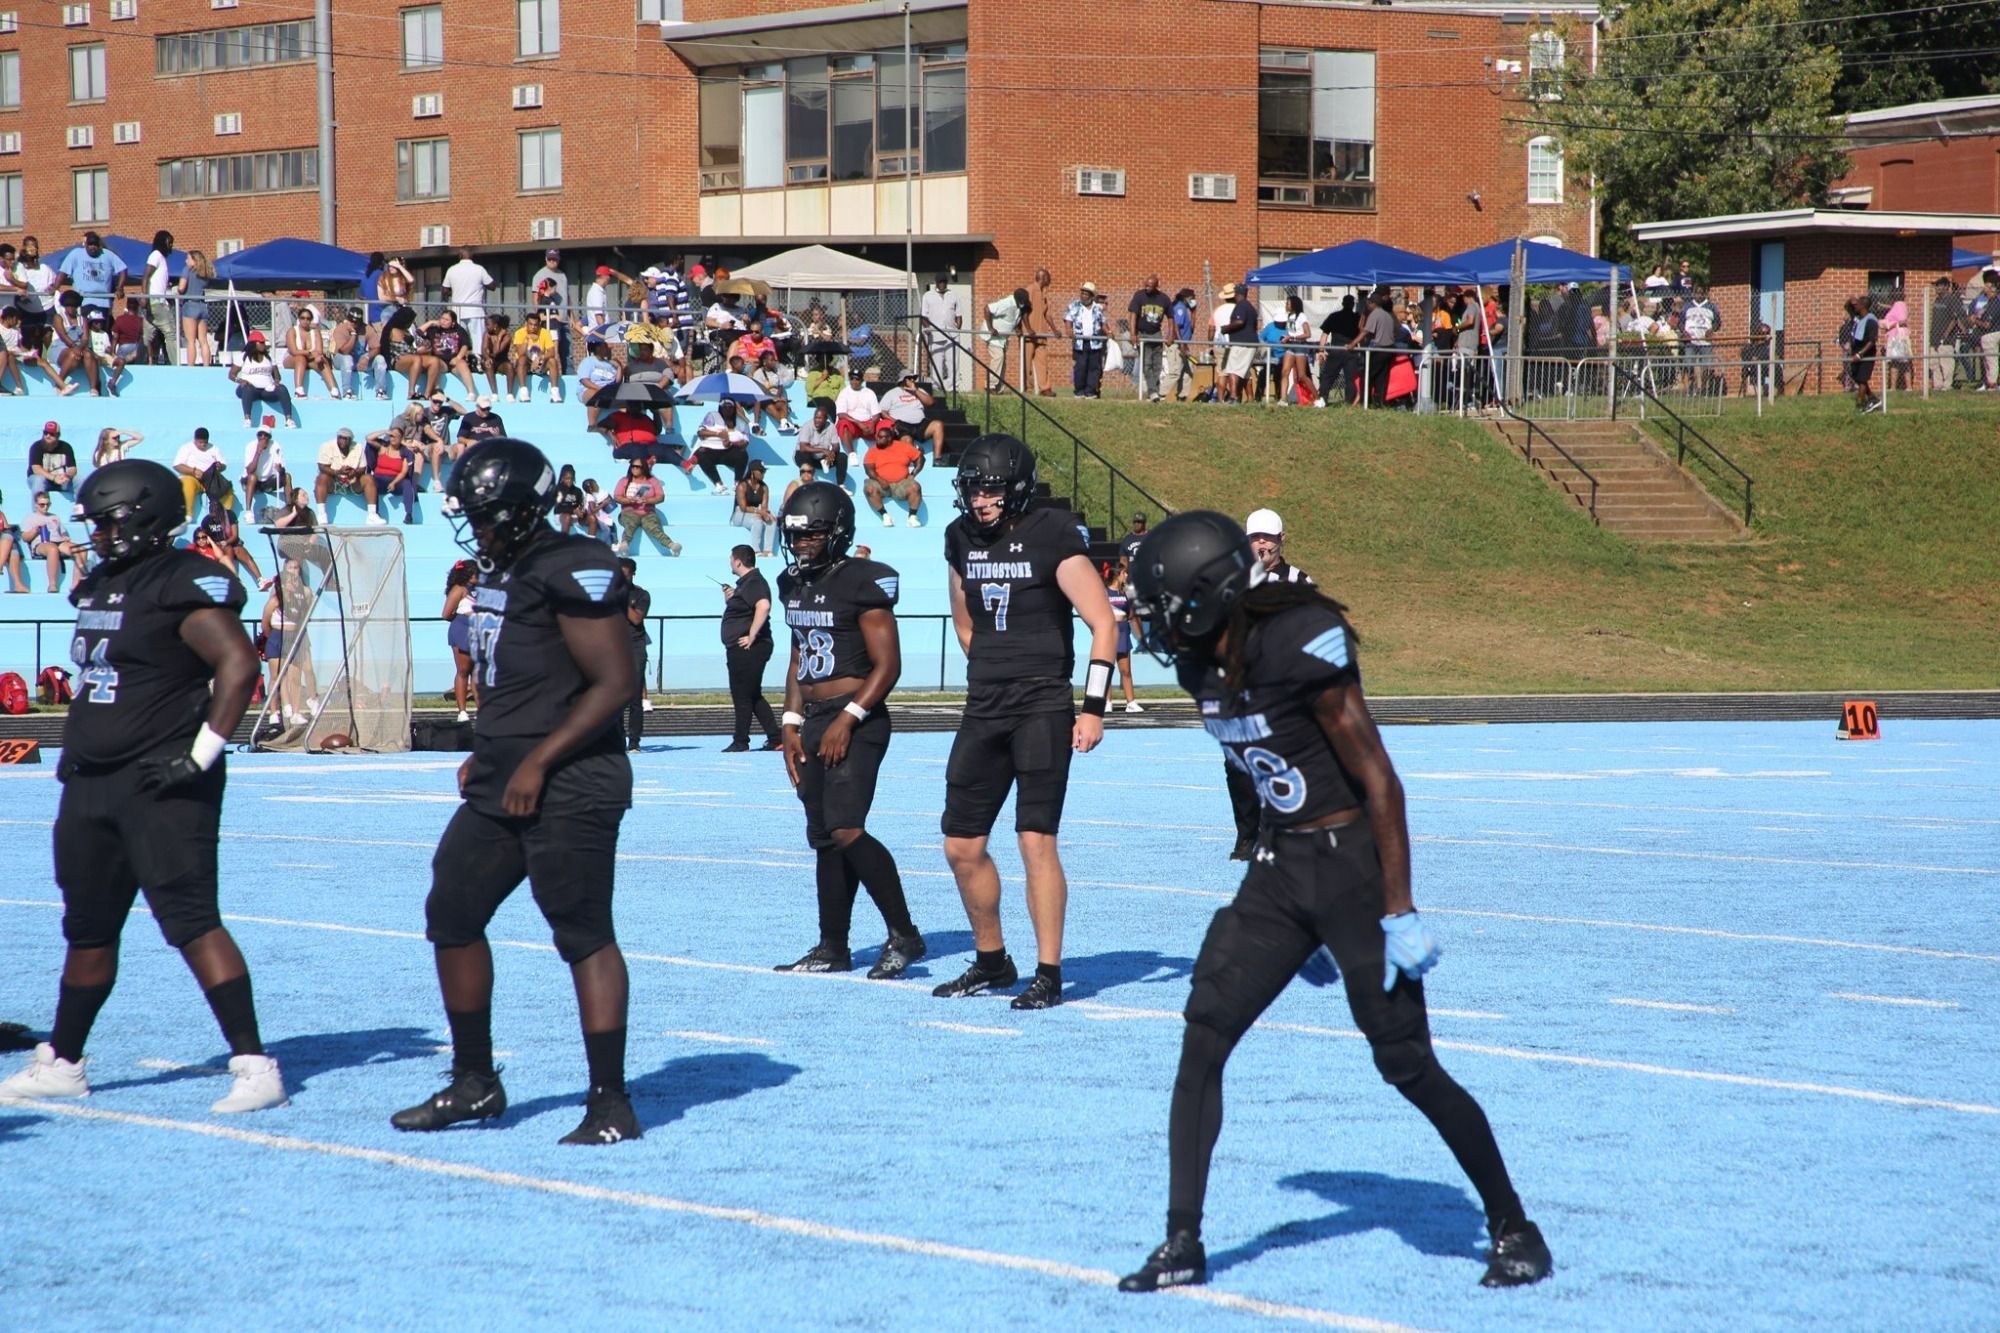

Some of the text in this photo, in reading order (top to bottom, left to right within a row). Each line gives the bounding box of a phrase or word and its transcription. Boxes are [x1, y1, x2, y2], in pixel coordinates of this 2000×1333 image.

[967, 562, 1032, 579] LIVINGSTONE
[968, 551, 989, 560] CIAA
[981, 583, 1011, 631] 7
[1847, 704, 1878, 736] 10
[1222, 746, 1307, 813] 8
